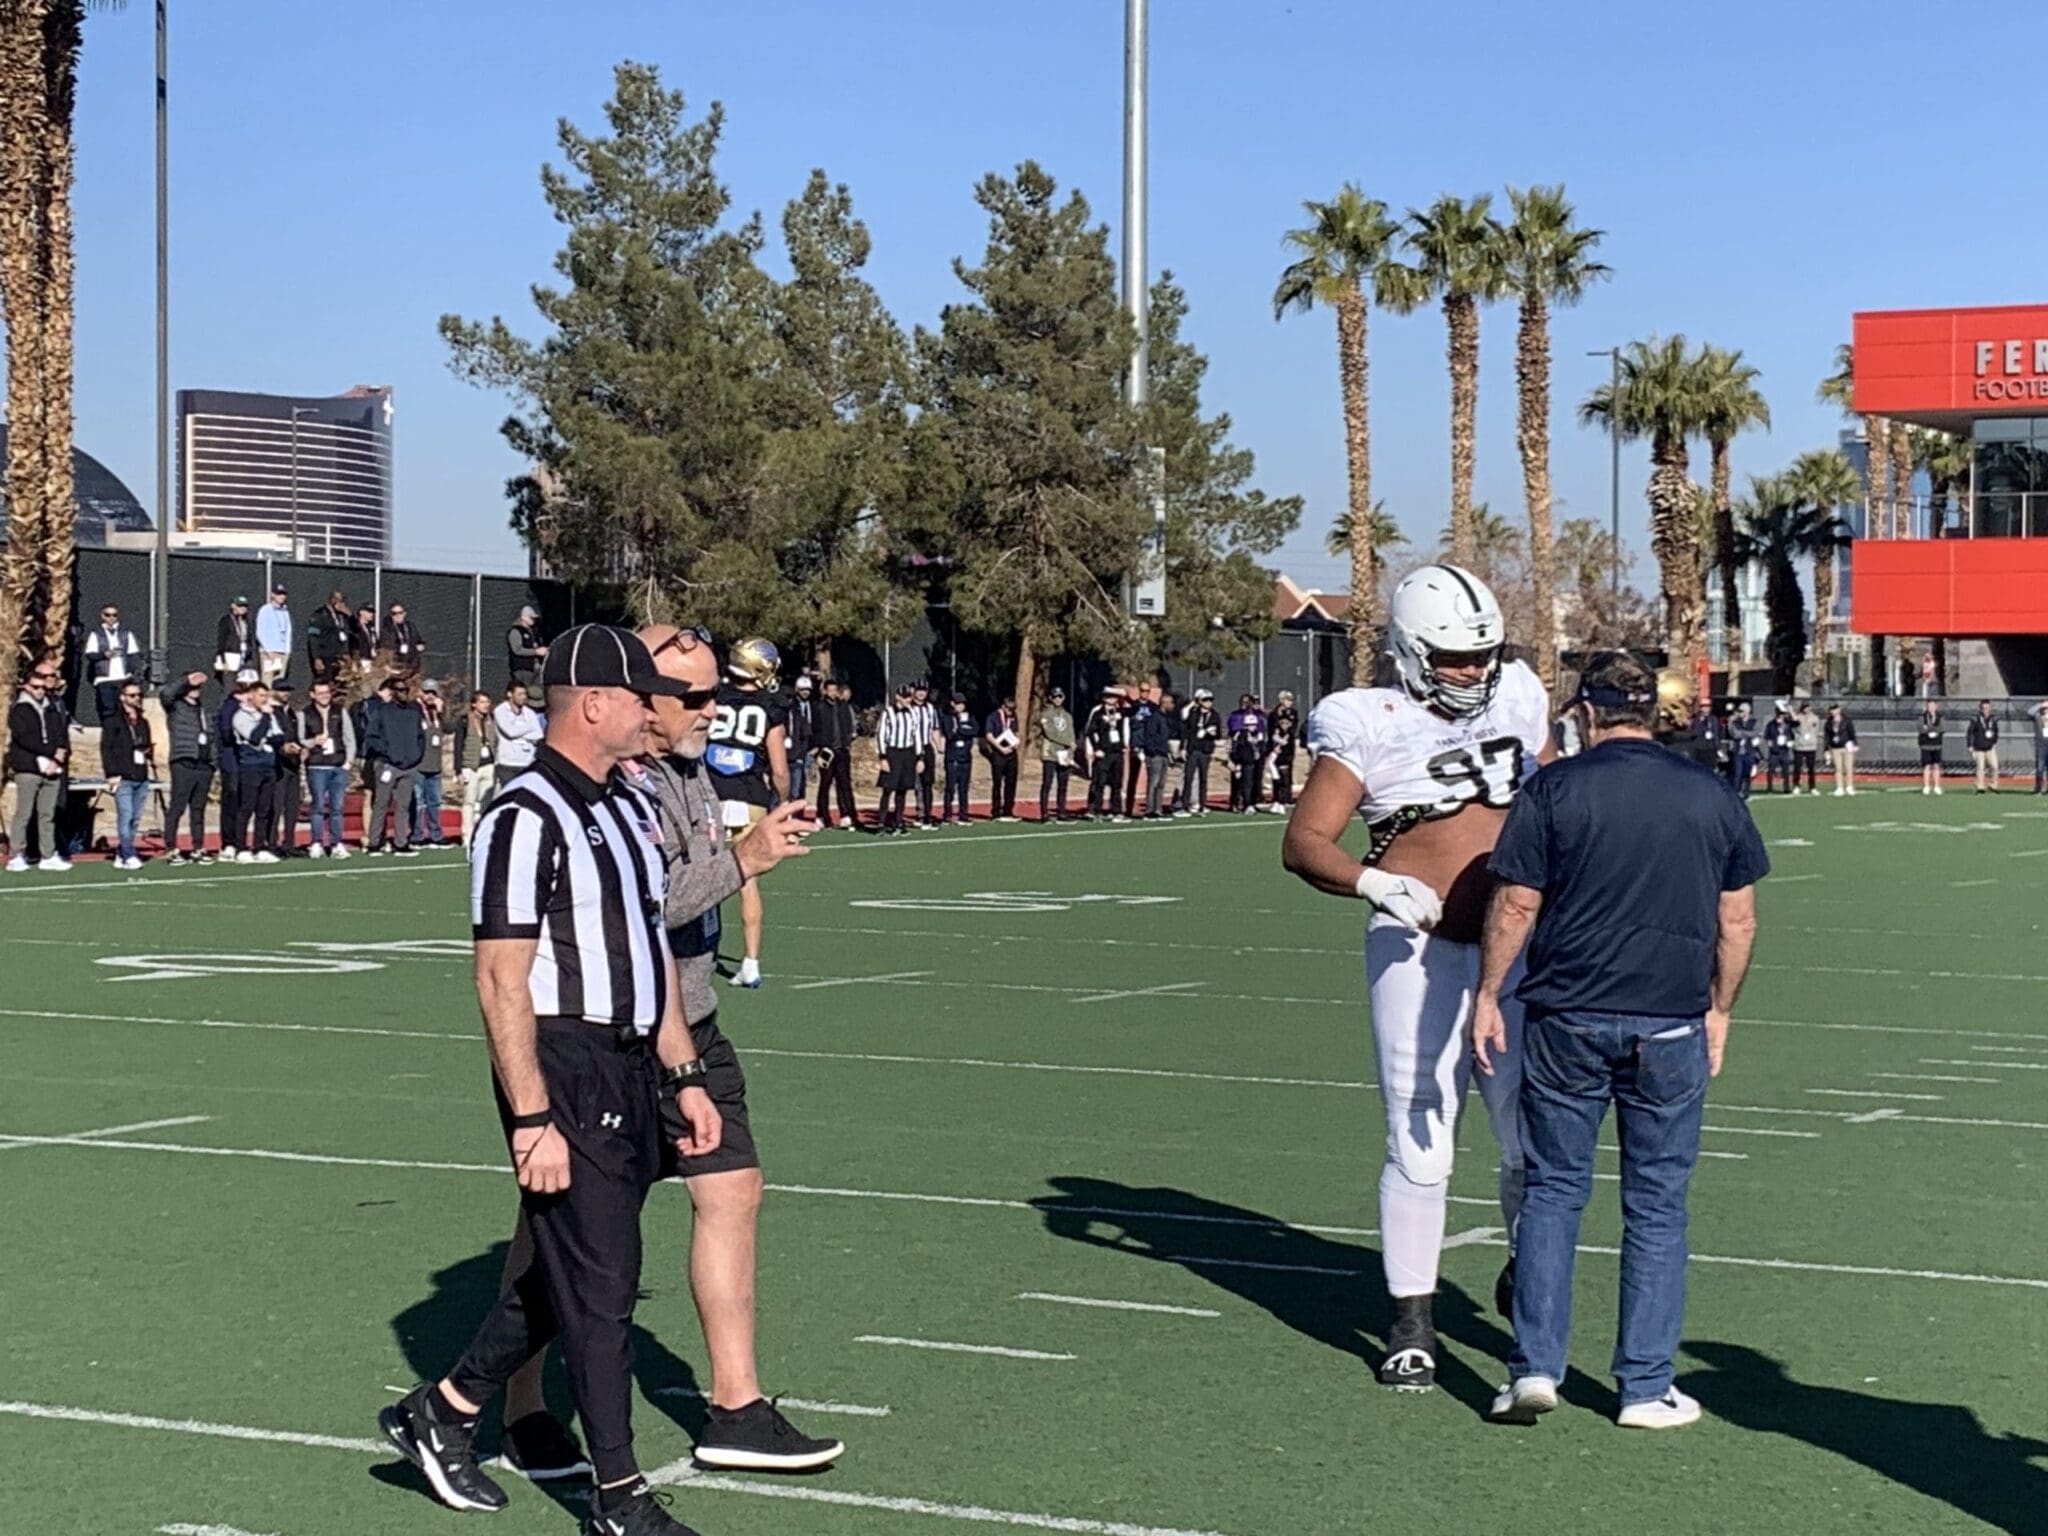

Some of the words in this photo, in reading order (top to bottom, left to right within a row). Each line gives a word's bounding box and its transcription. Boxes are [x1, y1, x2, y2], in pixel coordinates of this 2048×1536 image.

[1976, 339, 2048, 376] FER
[1426, 736, 1523, 821] 97
[587, 826, 603, 846] S
